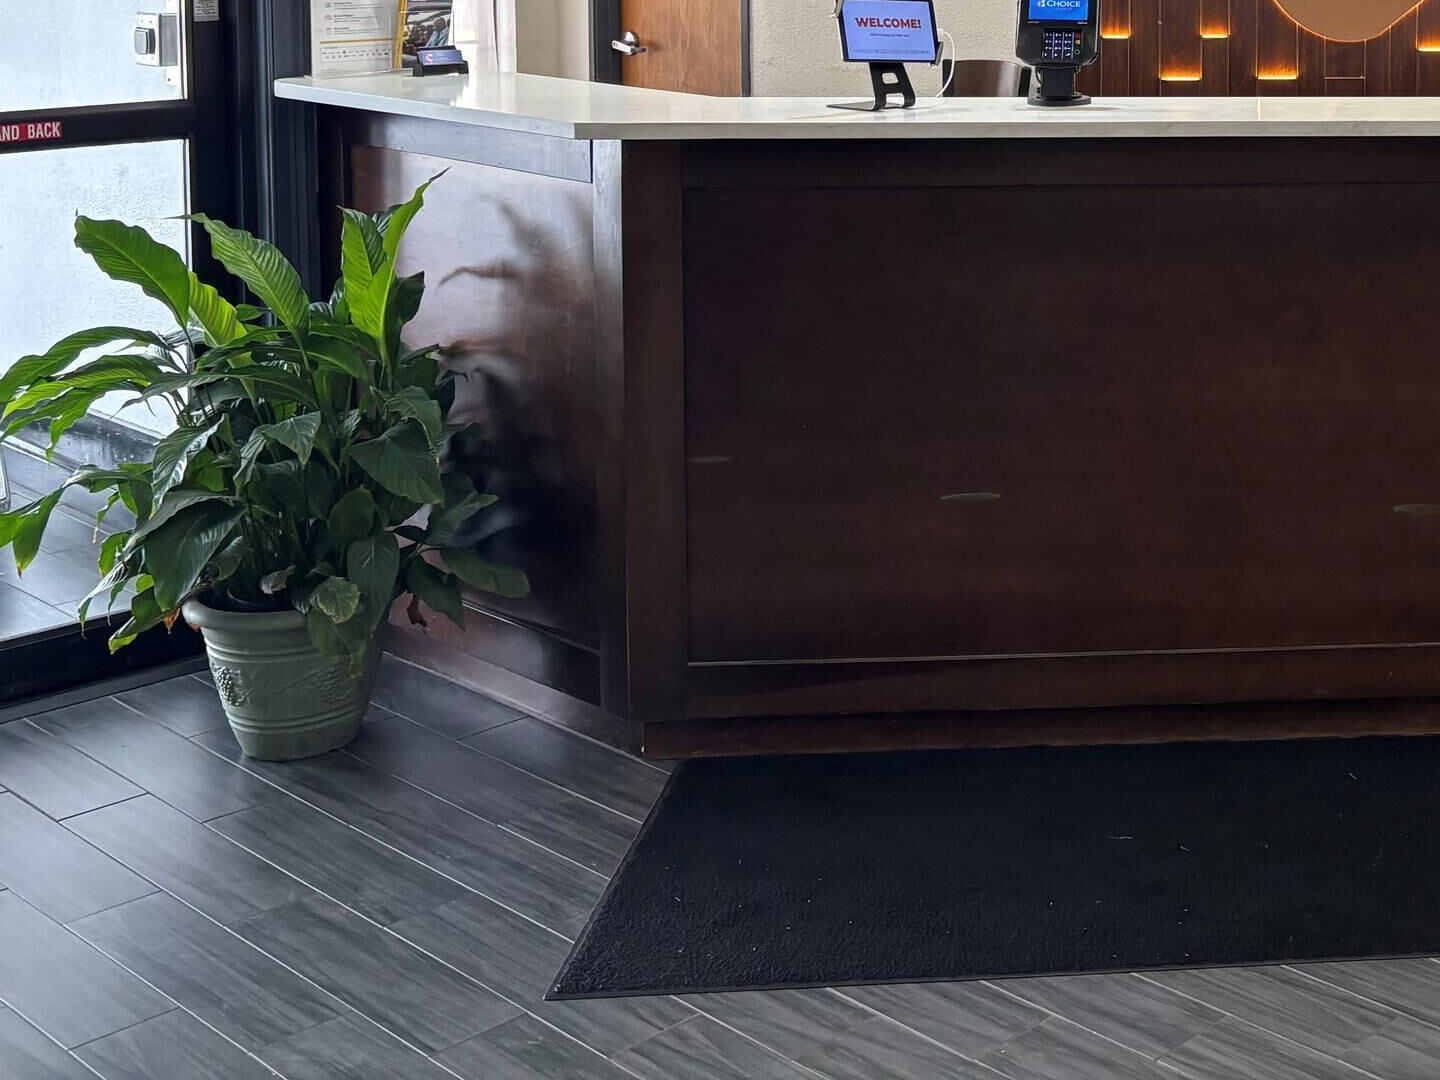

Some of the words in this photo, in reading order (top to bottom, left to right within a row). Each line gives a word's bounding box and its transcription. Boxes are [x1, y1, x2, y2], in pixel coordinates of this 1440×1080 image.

[1046, 0, 1081, 8] CHOICE
[854, 17, 922, 29] WELCOME!
[0, 125, 20, 141] ND
[28, 121, 61, 140] BACK
